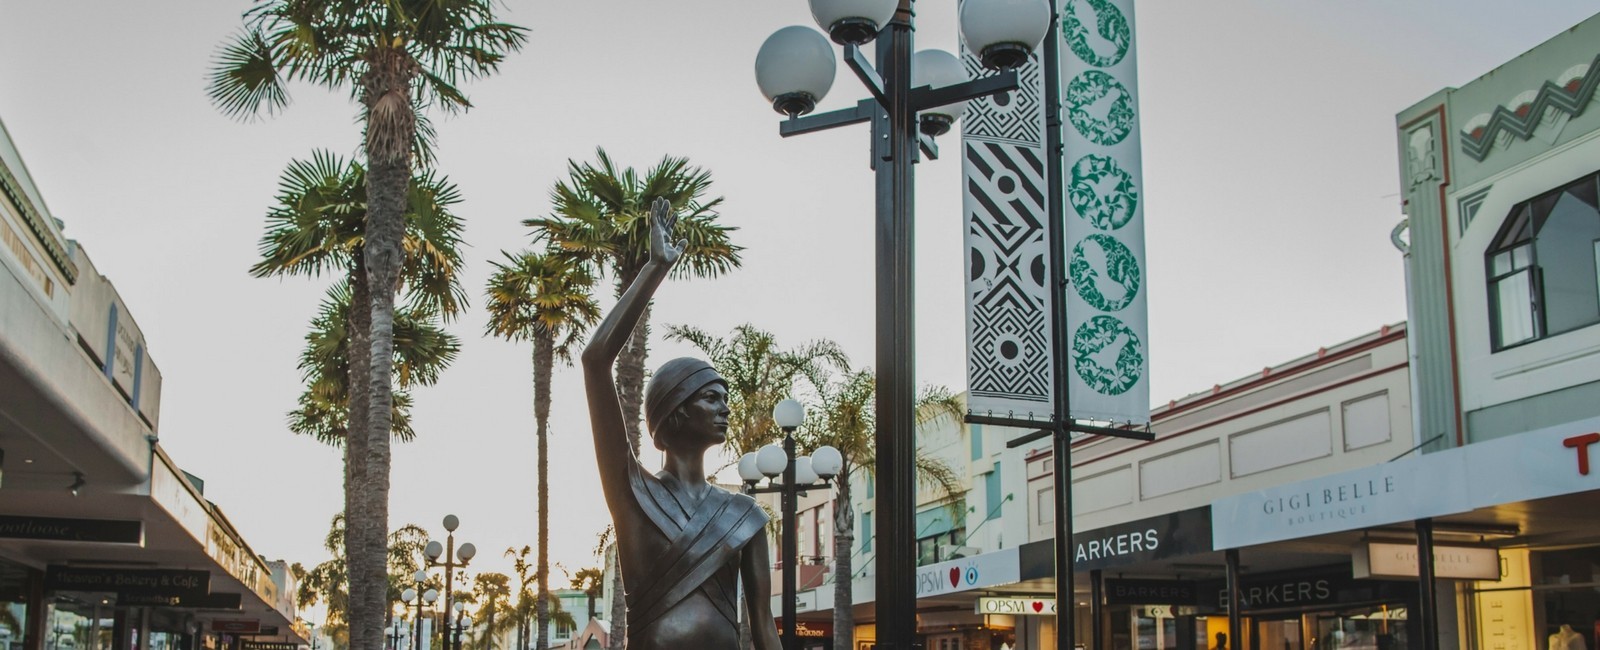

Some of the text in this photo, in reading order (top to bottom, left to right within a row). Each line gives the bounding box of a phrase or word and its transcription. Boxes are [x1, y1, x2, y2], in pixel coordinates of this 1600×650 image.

[1263, 476, 1395, 515] GIGI BELLE
[1289, 505, 1368, 526] BOUTIQUE
[1075, 529, 1159, 562] ARKERS
[115, 574, 157, 587] Bakery
[161, 575, 170, 586] &
[173, 574, 200, 589] Café
[1116, 585, 1190, 598] BARKERS
[986, 600, 1026, 613] OPSM
